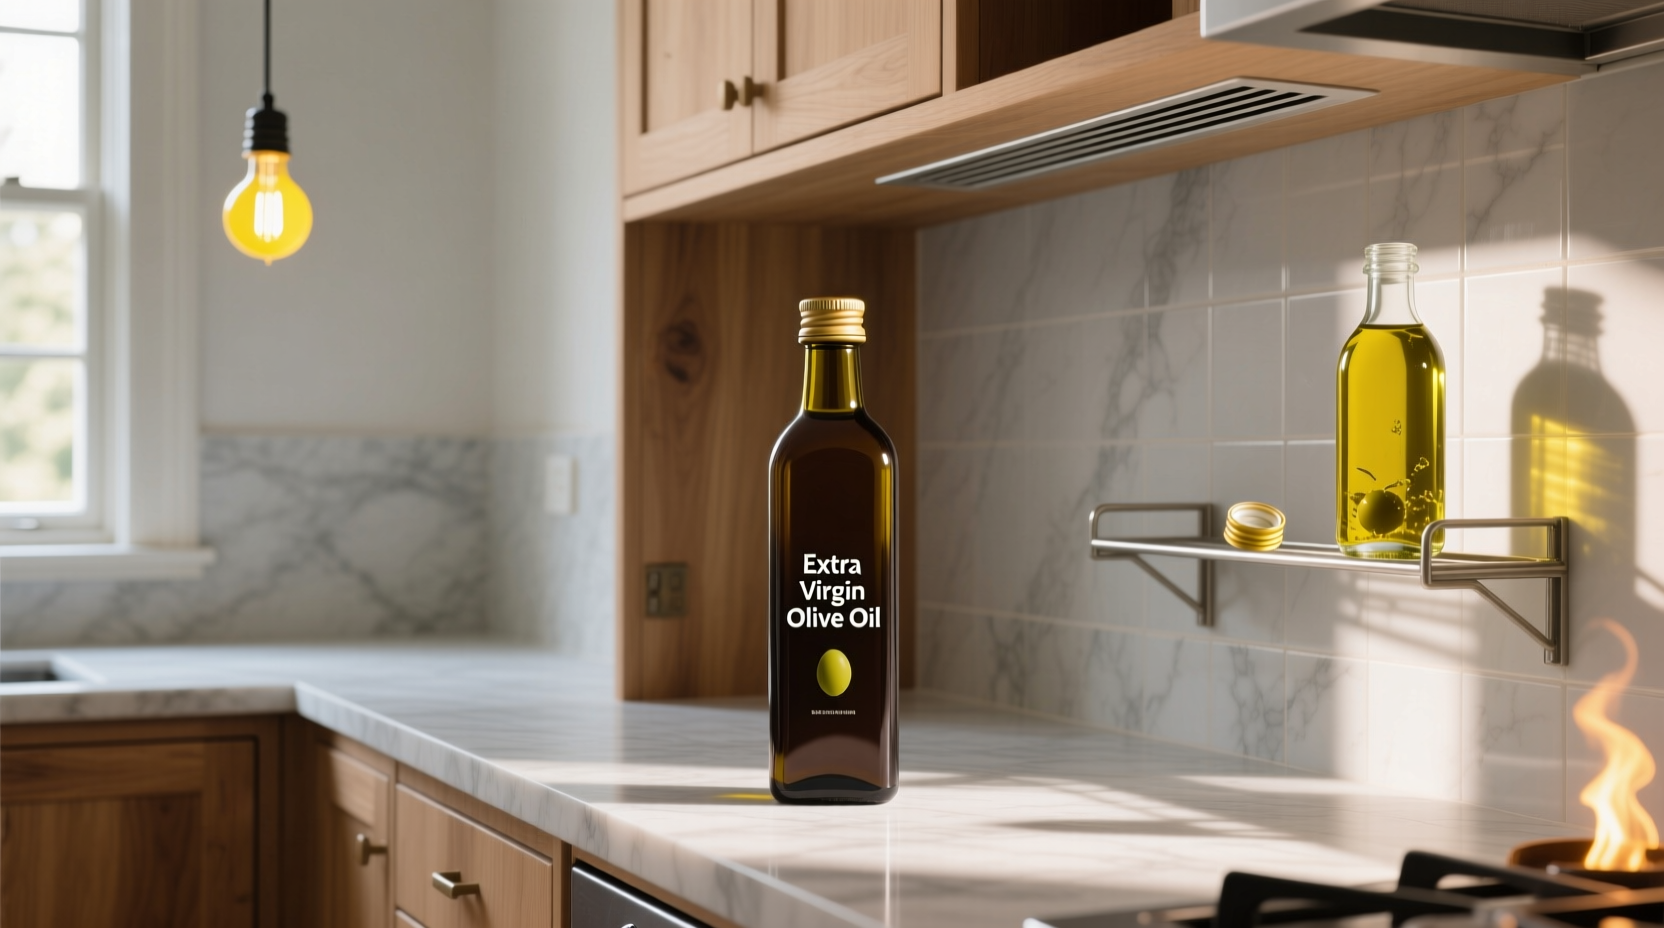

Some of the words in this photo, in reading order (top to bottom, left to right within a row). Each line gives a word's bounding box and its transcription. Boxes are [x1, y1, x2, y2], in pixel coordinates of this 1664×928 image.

[803, 553, 862, 575] Extra
[799, 579, 865, 606] Virgin
[786, 606, 844, 628] Olive
[849, 606, 881, 628] Oil
